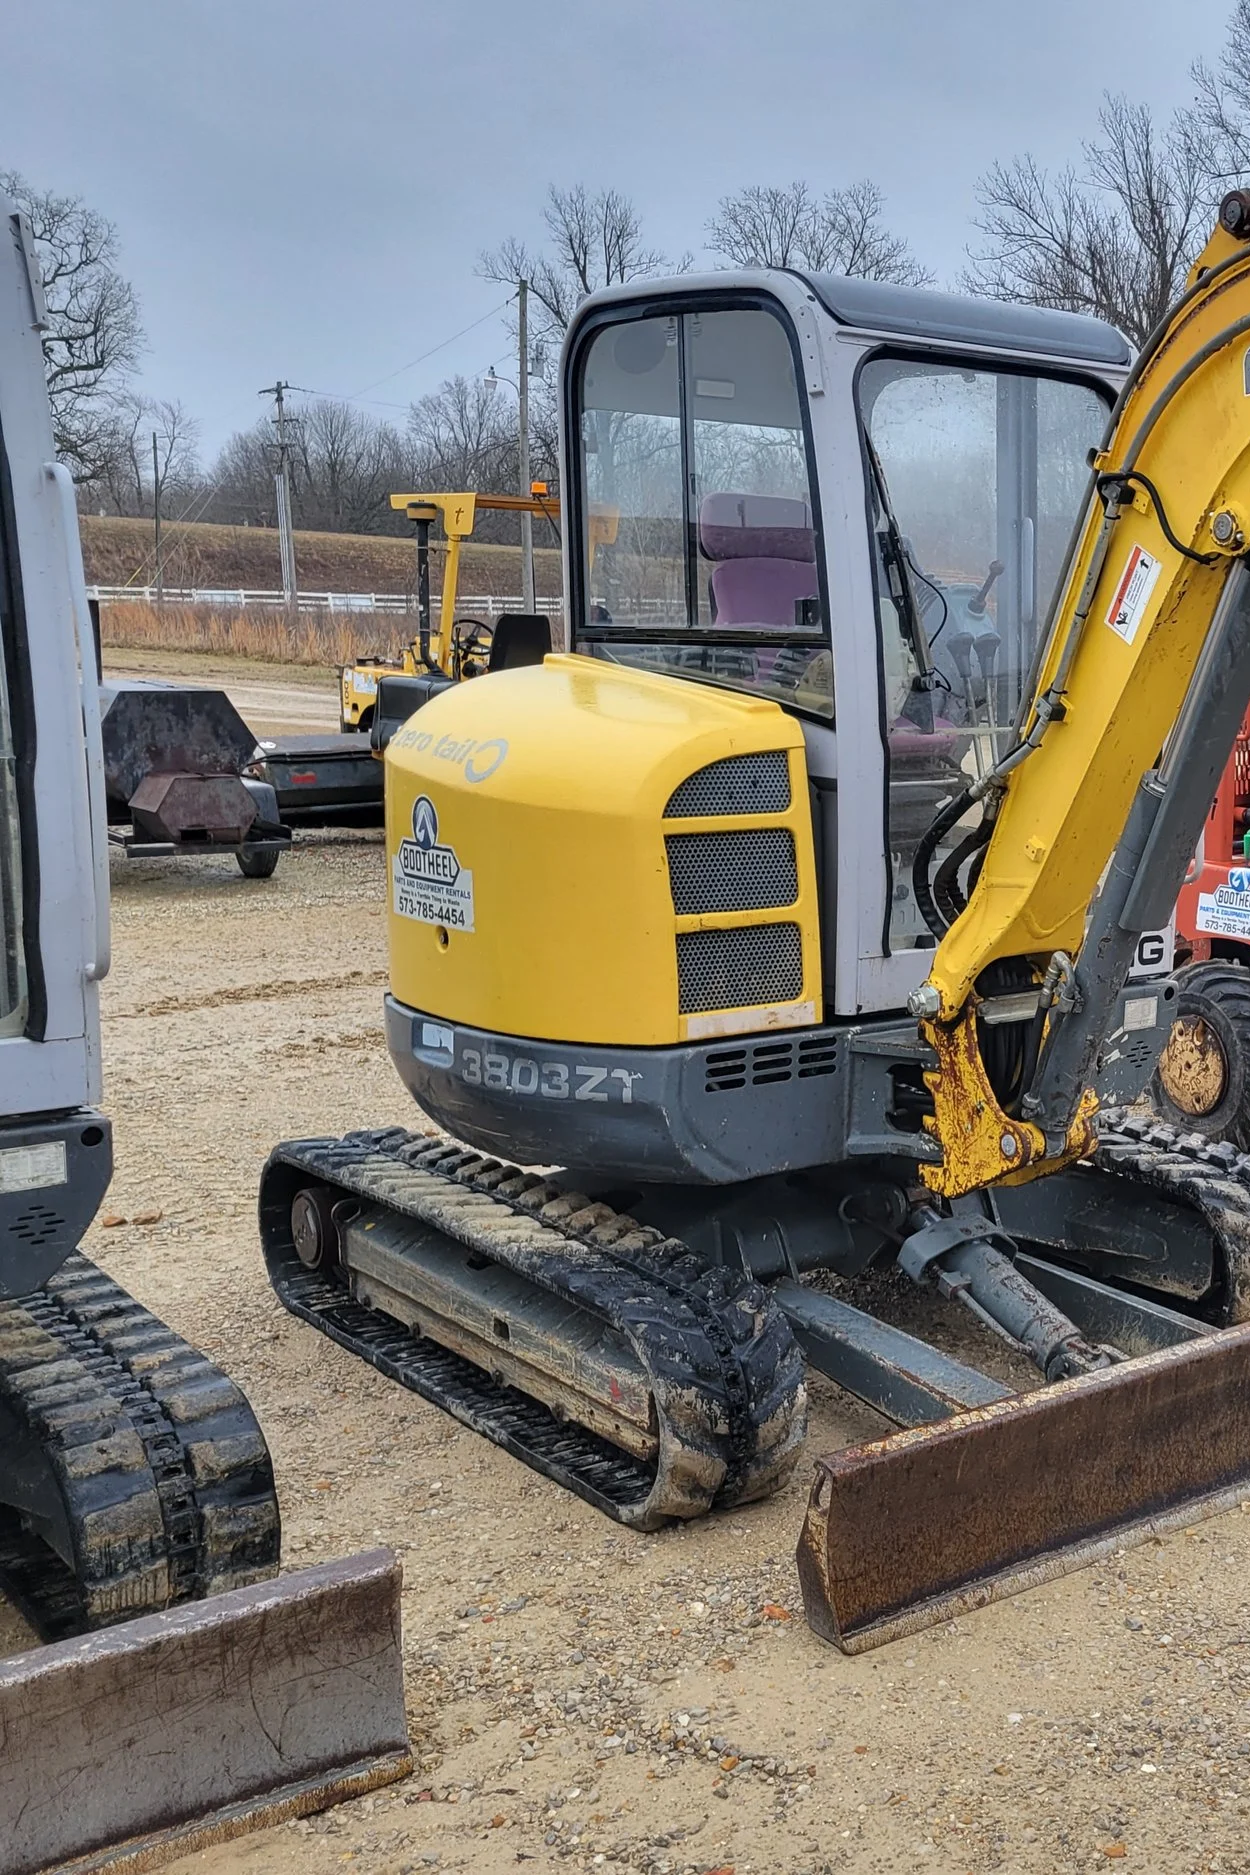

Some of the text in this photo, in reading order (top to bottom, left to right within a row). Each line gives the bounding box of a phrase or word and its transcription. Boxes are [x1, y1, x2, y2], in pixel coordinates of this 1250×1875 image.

[432, 733, 478, 764] tail
[402, 847, 457, 879] BOOTHEEL
[416, 881, 444, 895] EQUIPMENT
[446, 887, 471, 900] RENTALS
[399, 896, 466, 926] 573-785-4454
[1199, 905, 1215, 914] PARTS
[1221, 909, 1250, 919] EQUIPMENT
[462, 1049, 640, 1104] 3803ZT
